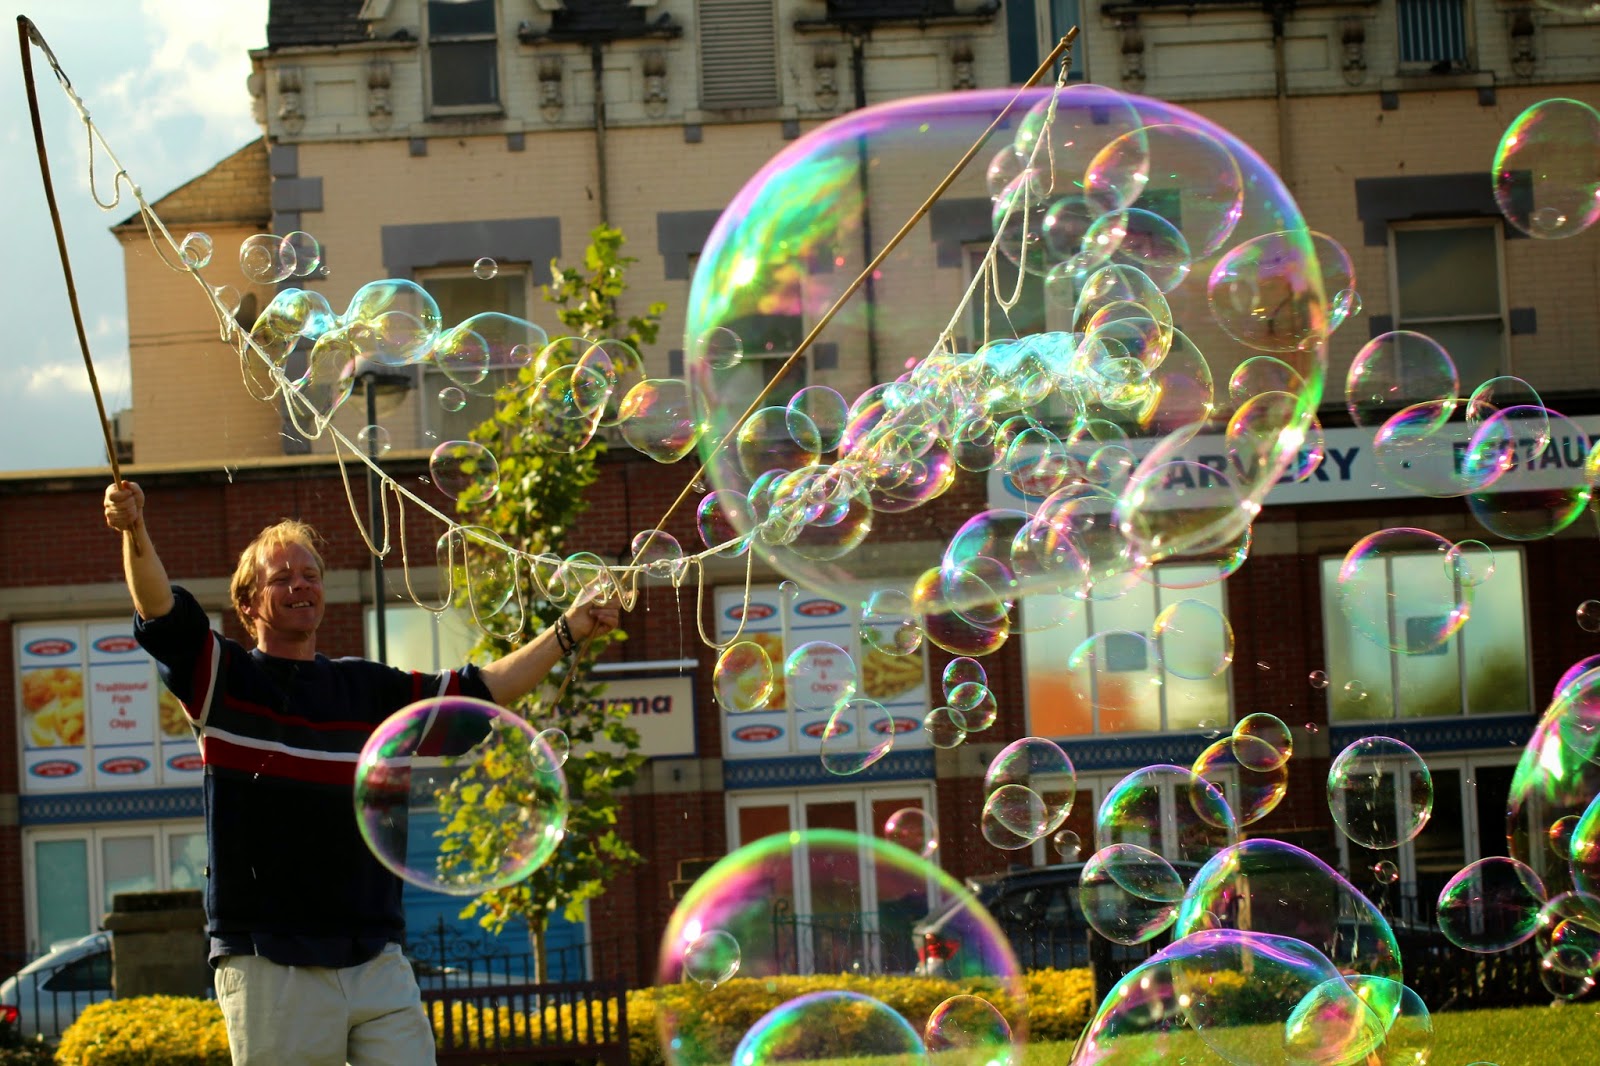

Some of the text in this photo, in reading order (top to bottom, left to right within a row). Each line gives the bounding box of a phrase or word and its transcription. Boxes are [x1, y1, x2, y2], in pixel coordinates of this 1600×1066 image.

[1129, 447, 1360, 491] ARVERY
[1453, 433, 1600, 474] RESTAU
[95, 681, 148, 692] Traditional
[111, 694, 132, 704] Fish
[109, 719, 137, 731] Chips
